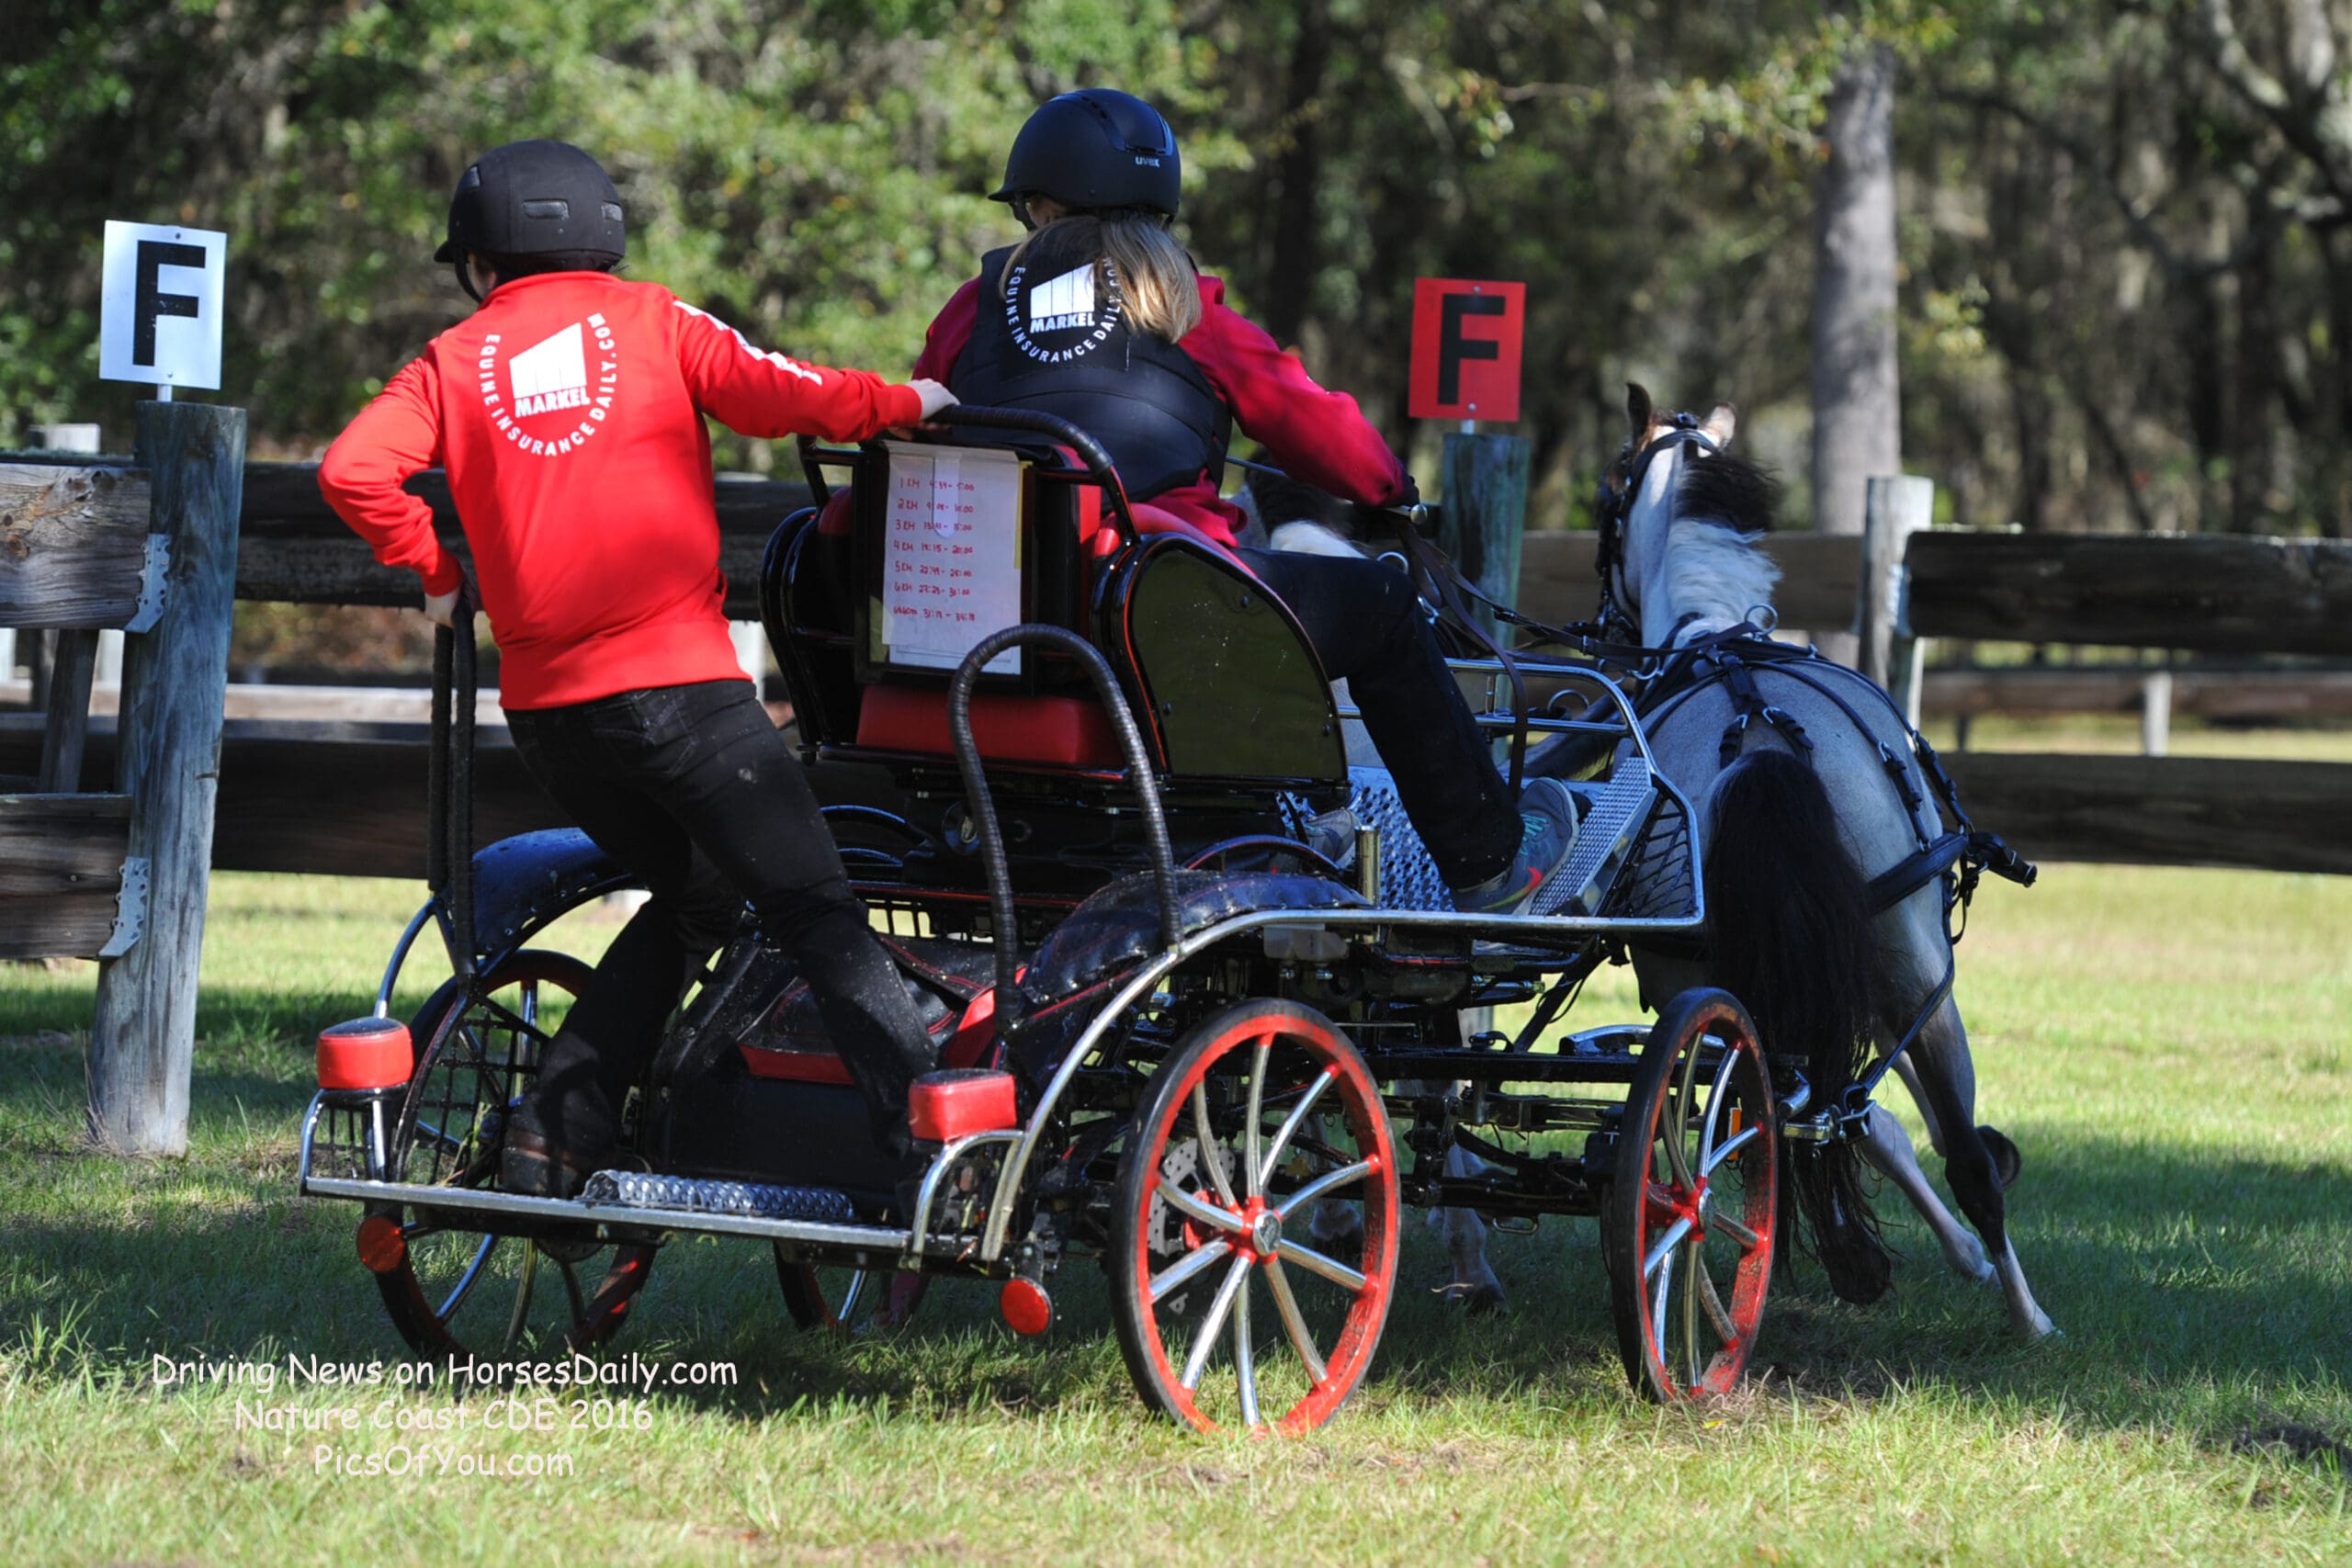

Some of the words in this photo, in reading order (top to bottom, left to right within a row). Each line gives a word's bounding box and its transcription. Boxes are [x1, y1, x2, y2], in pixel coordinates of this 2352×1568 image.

[1135, 156, 1160, 168] uvex
[132, 240, 207, 367] F
[1005, 265, 1027, 326] EQUINE
[1012, 326, 1097, 364] INSURANCE
[1029, 312, 1096, 334] MARKEL
[1438, 293, 1507, 405] F
[478, 333, 502, 406] EQUINE
[490, 407, 596, 457] INSURANCE
[514, 386, 592, 419] MARKEL
